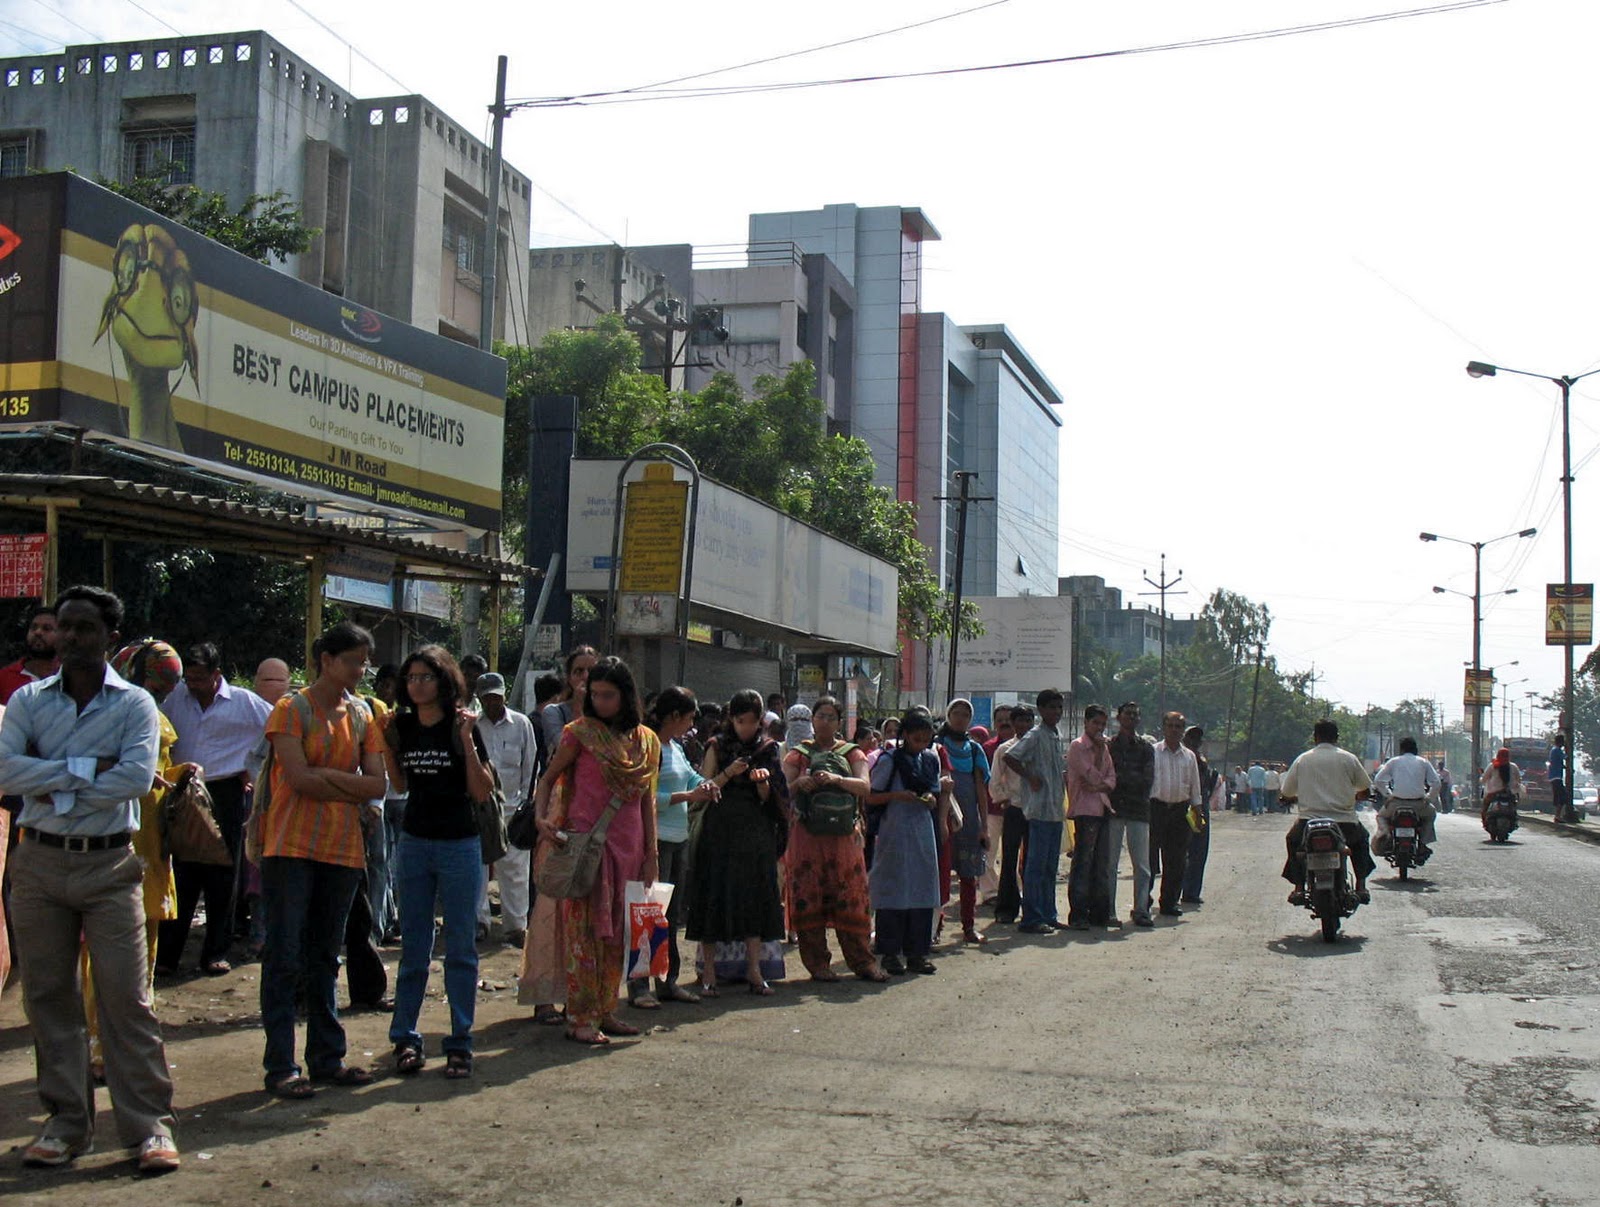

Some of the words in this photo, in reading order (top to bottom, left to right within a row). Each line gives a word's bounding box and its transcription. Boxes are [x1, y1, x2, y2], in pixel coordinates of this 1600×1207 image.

[290, 320, 320, 347] Leaders
[330, 338, 340, 353] 3D
[341, 343, 376, 369] Animation
[376, 356, 383, 371] &
[384, 359, 399, 375] VFX
[399, 364, 424, 388] Training
[0, 396, 30, 416] 135
[233, 343, 281, 387] BEST
[289, 364, 360, 414] CAMPUS
[366, 392, 464, 448] PLACEMENTS
[309, 415, 326, 431] Our
[328, 420, 359, 445] Parting
[360, 431, 376, 447] Gift
[377, 437, 387, 450] To
[389, 440, 404, 456] You
[328, 446, 336, 463] J
[340, 449, 351, 468] M
[355, 454, 387, 477] Road
[224, 441, 243, 461] Tel-
[246, 448, 299, 479] 25513134,
[301, 463, 346, 490] 25513135
[348, 476, 375, 496] Email-
[376, 484, 466, 520] jmroad@maacmail.com
